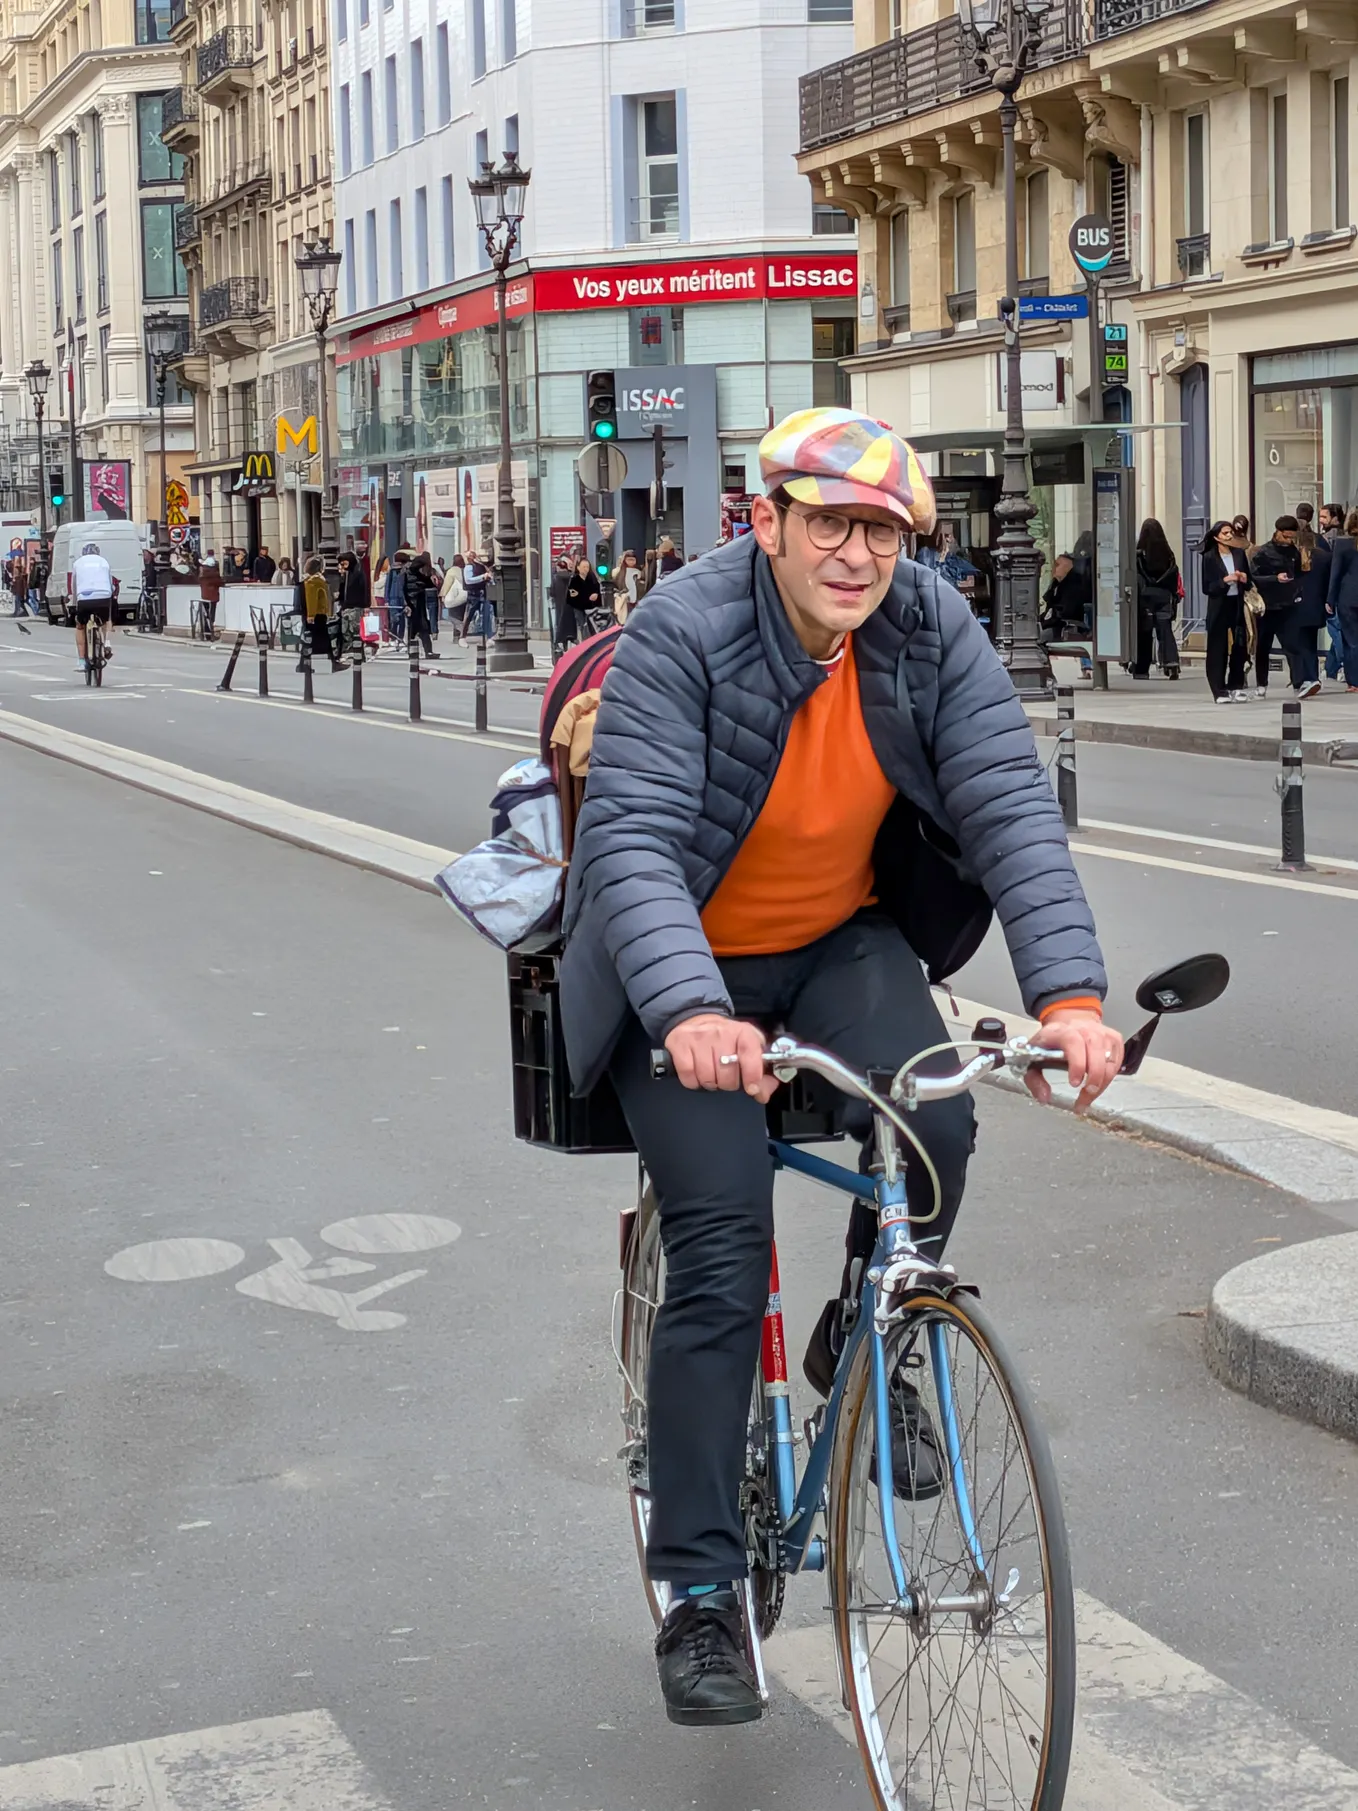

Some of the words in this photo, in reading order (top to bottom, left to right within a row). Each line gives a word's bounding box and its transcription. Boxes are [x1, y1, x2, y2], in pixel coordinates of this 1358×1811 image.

[1077, 227, 1110, 246] BUS
[573, 277, 611, 299] Vos
[615, 277, 665, 302] yeux
[669, 267, 756, 293] méritent
[768, 265, 853, 287] Lissac
[1107, 356, 1124, 369] 74
